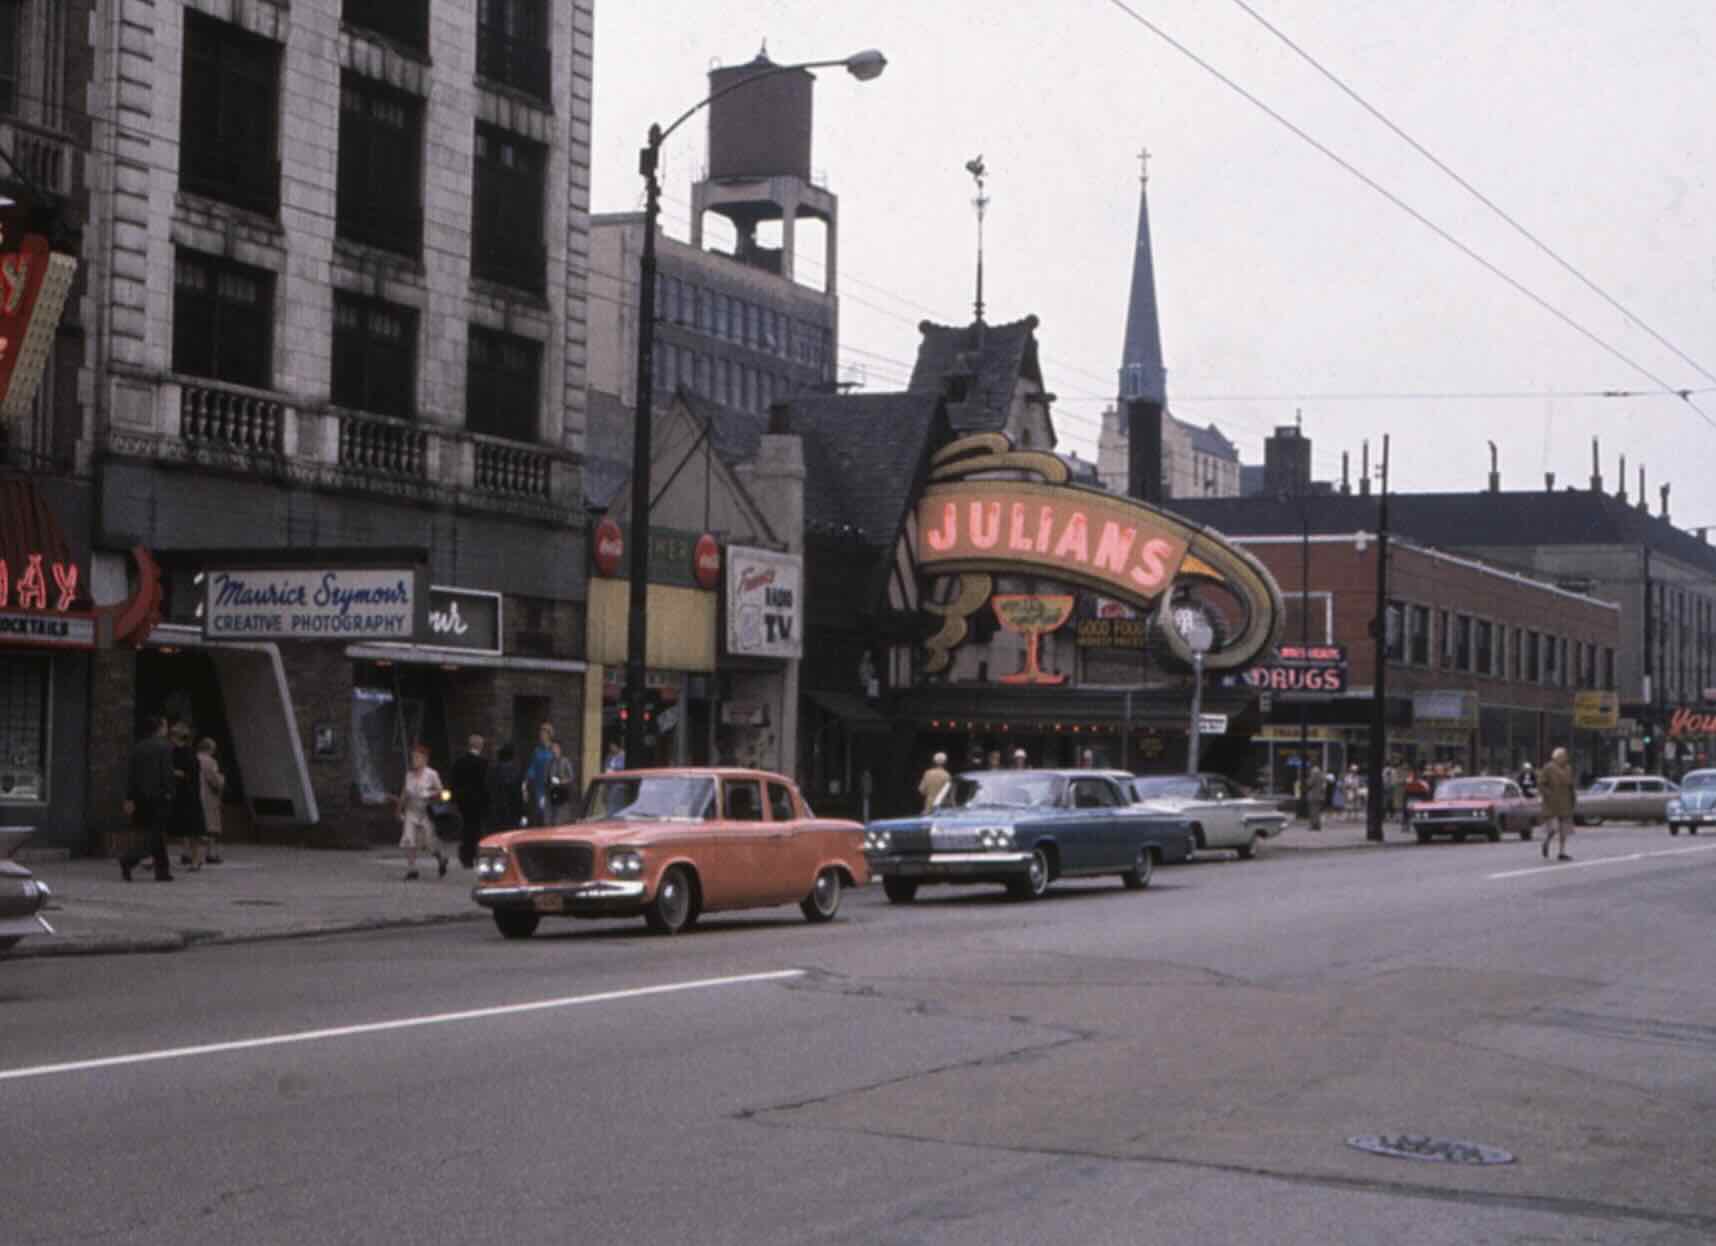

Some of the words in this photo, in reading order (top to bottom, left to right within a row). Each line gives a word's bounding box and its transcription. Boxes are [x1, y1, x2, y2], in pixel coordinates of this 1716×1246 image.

[927, 501, 1169, 586] JULIANS
[214, 573, 307, 606] Maurice
[313, 571, 409, 616] Seymour
[213, 615, 282, 632] CREATIVE
[290, 615, 405, 632] PHOTOGRAPHY
[764, 613, 793, 643] TV
[1251, 667, 1340, 689] DRUGS
